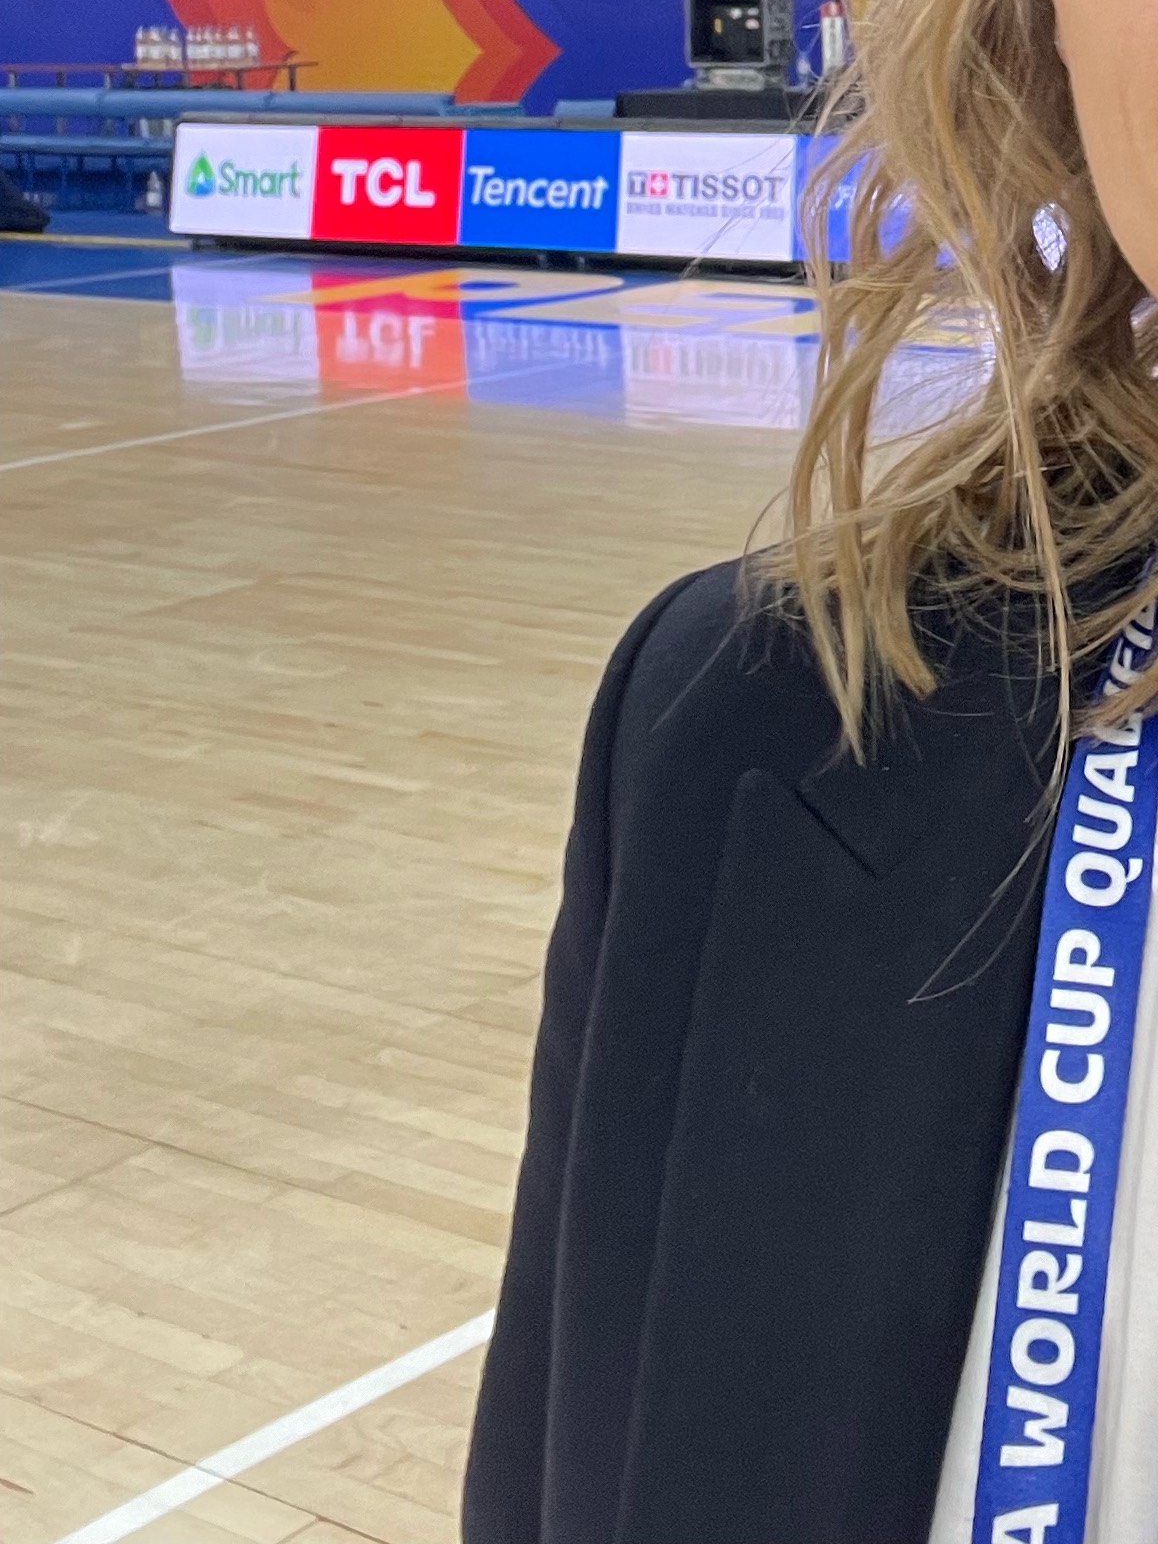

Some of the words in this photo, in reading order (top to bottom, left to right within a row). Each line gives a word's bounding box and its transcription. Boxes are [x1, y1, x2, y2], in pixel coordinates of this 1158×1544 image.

[218, 159, 301, 199] Smart
[331, 158, 436, 208] TCL
[468, 166, 609, 209] Tencent
[671, 172, 785, 202] TISSOT
[1040, 928, 1116, 1105] CUP
[1000, 1129, 1096, 1468] WORLD
